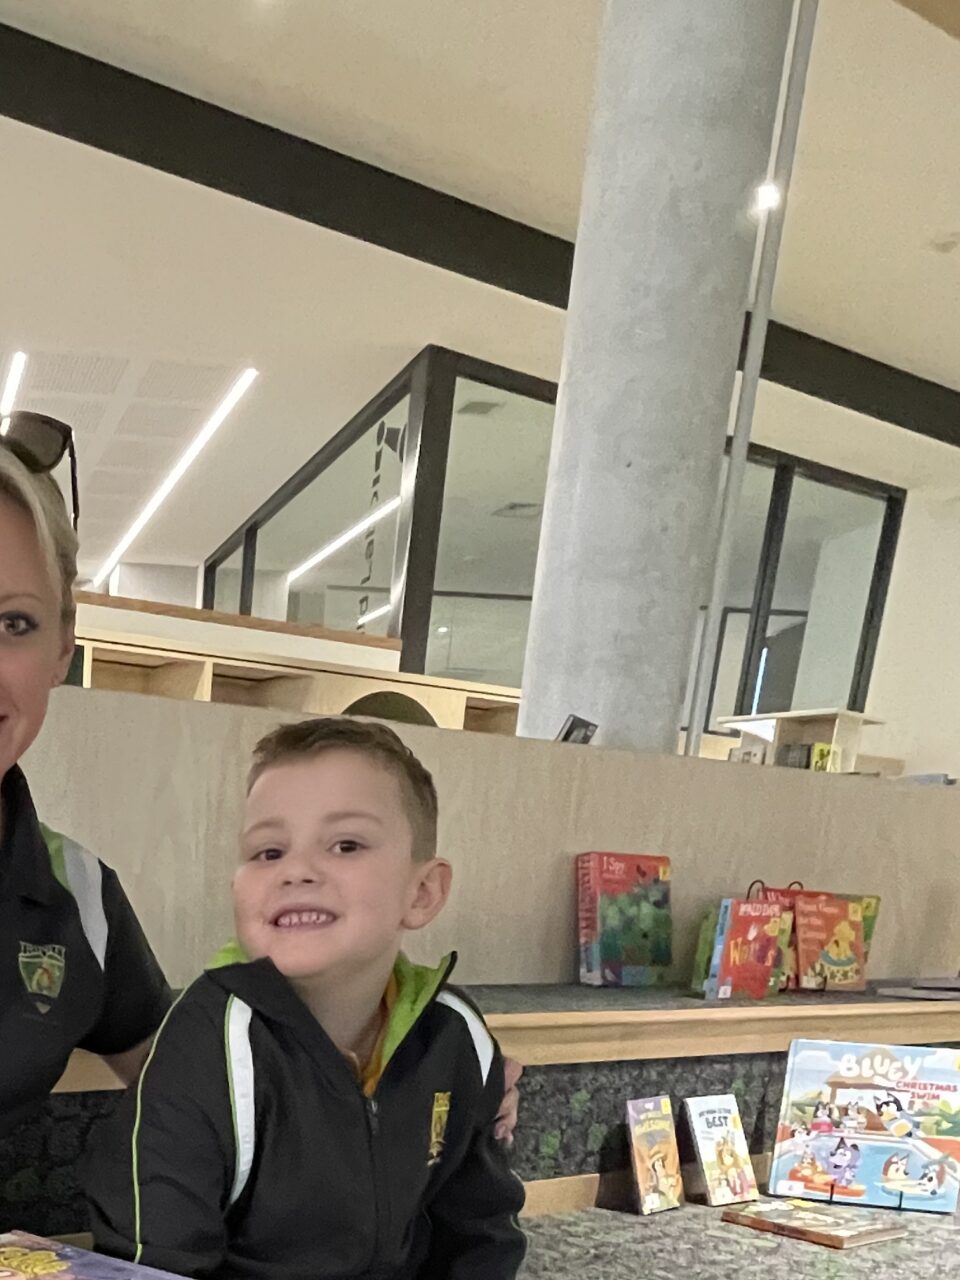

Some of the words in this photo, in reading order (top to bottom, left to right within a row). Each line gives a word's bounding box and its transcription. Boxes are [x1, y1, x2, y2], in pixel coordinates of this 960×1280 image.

[839, 1054, 921, 1081] BLUEY
[895, 1081, 958, 1092] CHRISTMAS
[910, 1092, 941, 1100] SWIM
[705, 1116, 729, 1129] BEST
